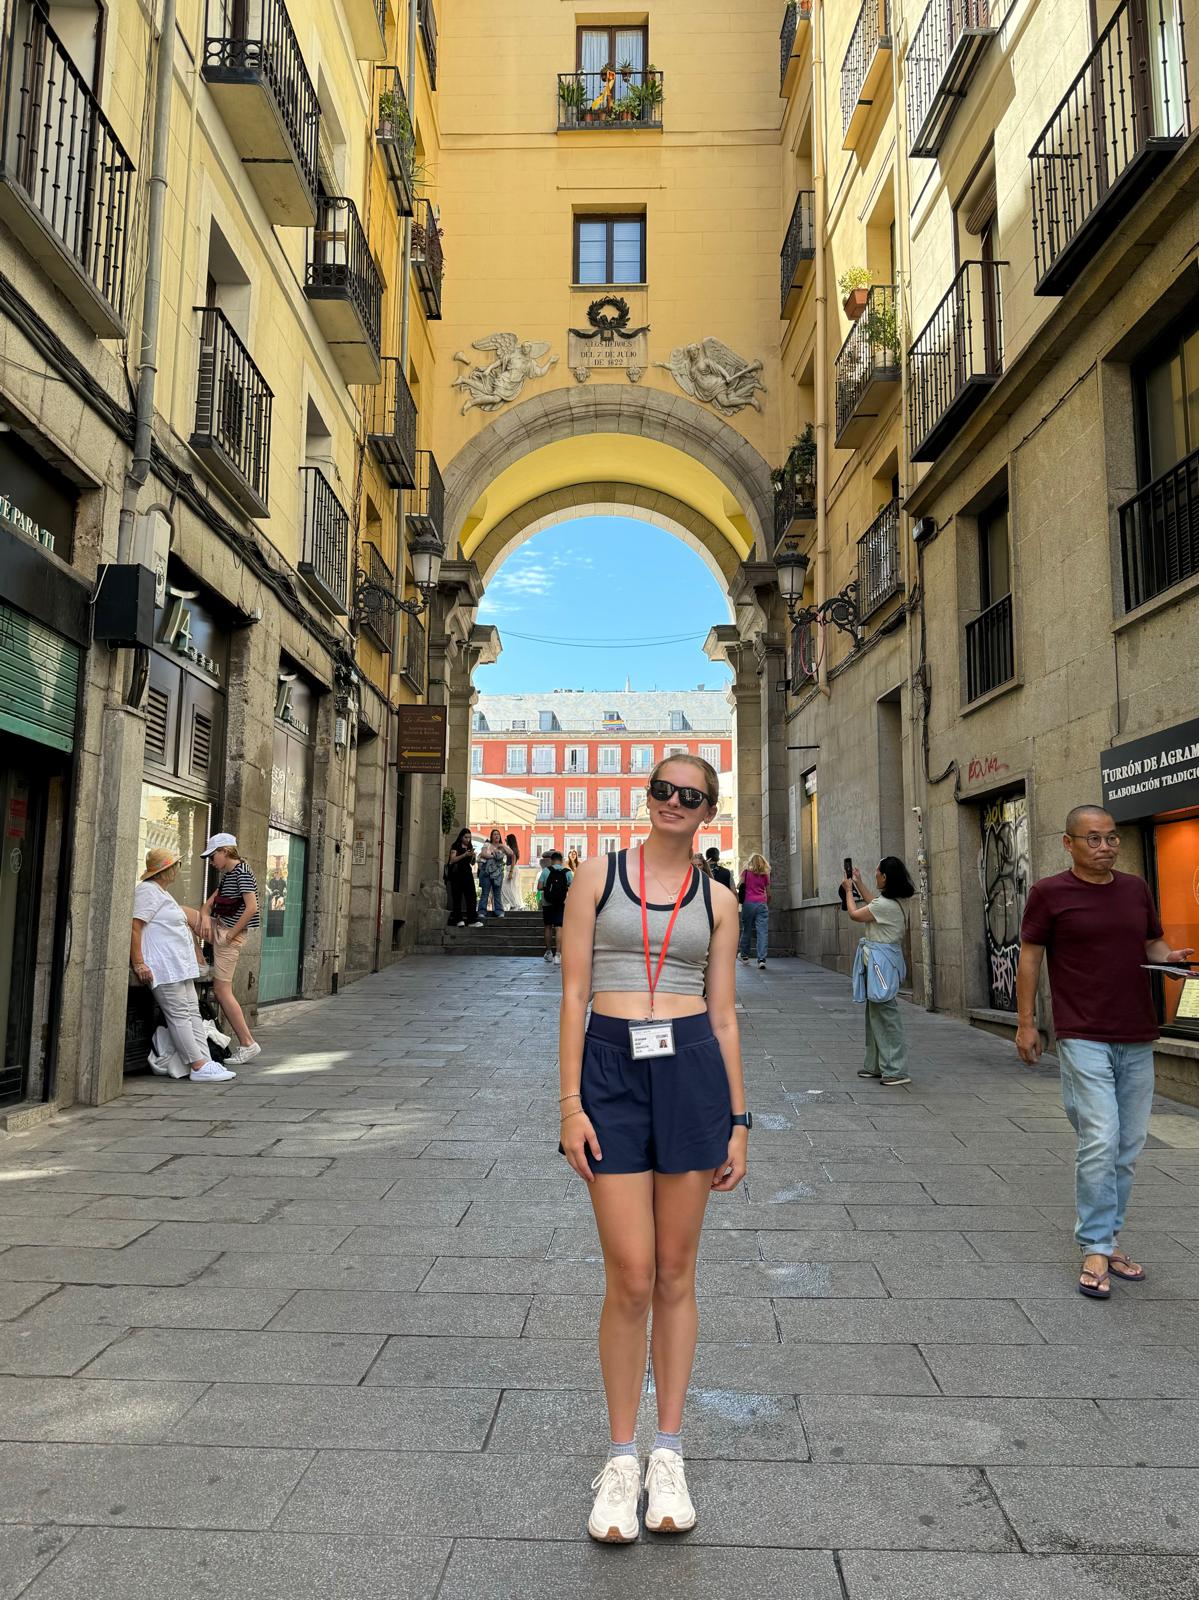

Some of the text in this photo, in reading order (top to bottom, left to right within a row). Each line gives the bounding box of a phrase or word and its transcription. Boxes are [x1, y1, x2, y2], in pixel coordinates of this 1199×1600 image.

[14, 507, 39, 541] PARA
[41, 529, 55, 551] TI
[1102, 743, 1199, 784] TURRÓN DE AGRAM
[1108, 778, 1160, 800] ELABORACIÓN
